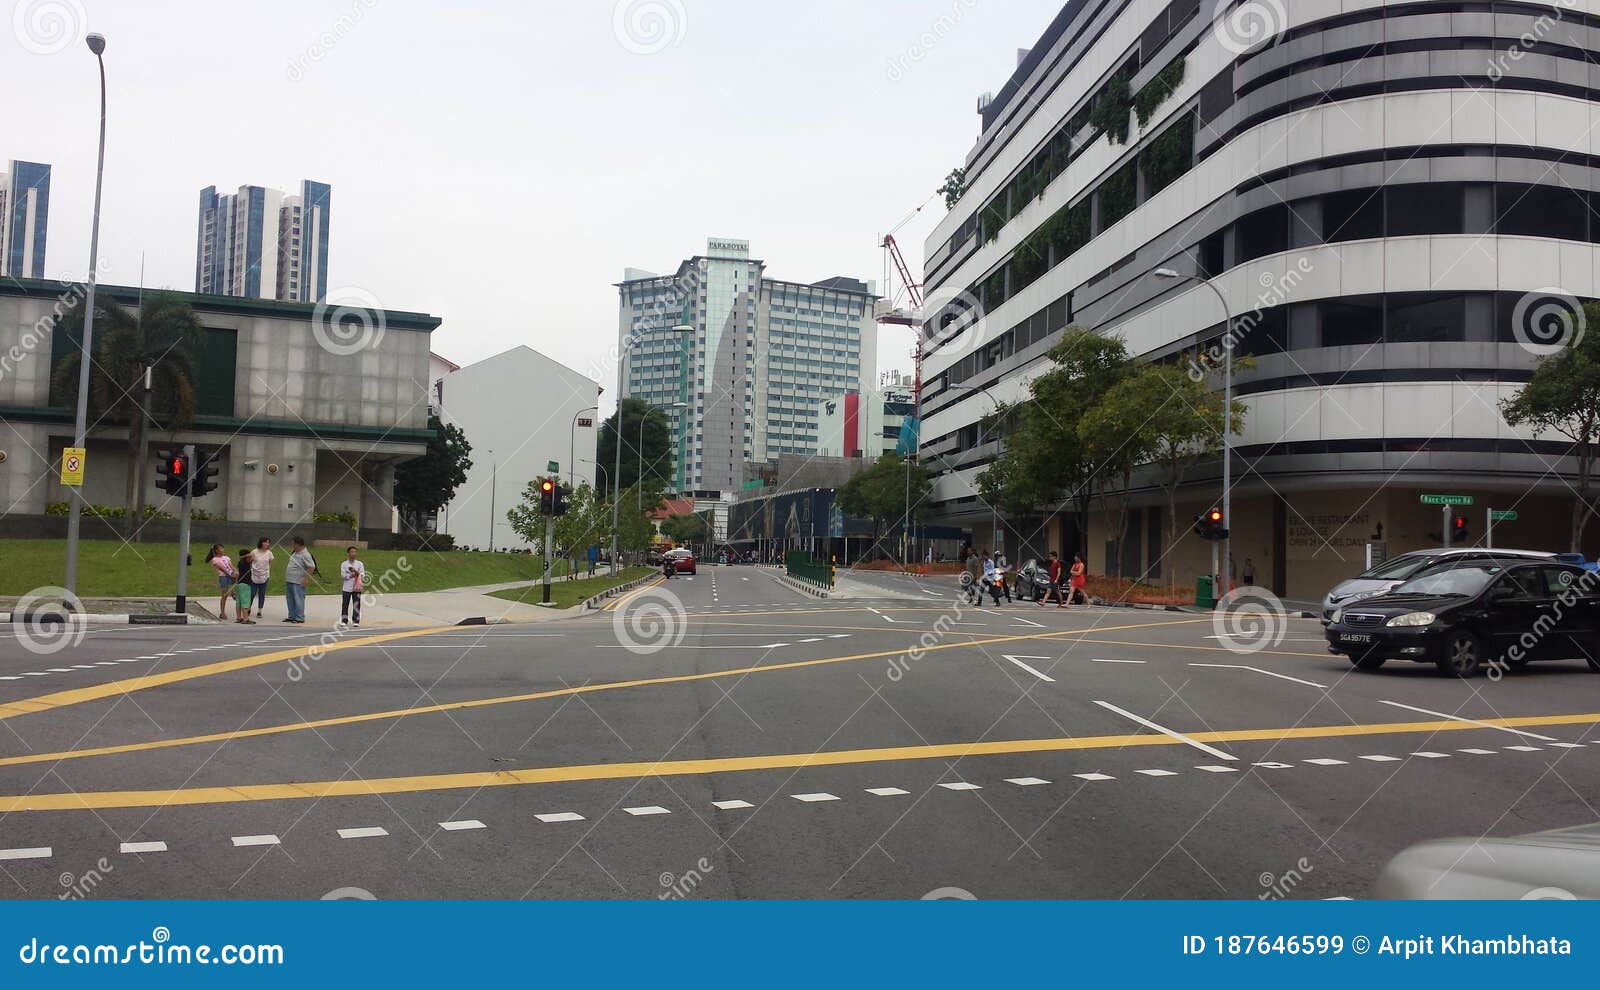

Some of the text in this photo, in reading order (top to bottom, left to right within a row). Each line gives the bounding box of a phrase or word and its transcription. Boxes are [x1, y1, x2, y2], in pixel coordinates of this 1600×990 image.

[709, 241, 748, 252] PARKROYAL
[1424, 495, 1471, 505] Race Course Rd
